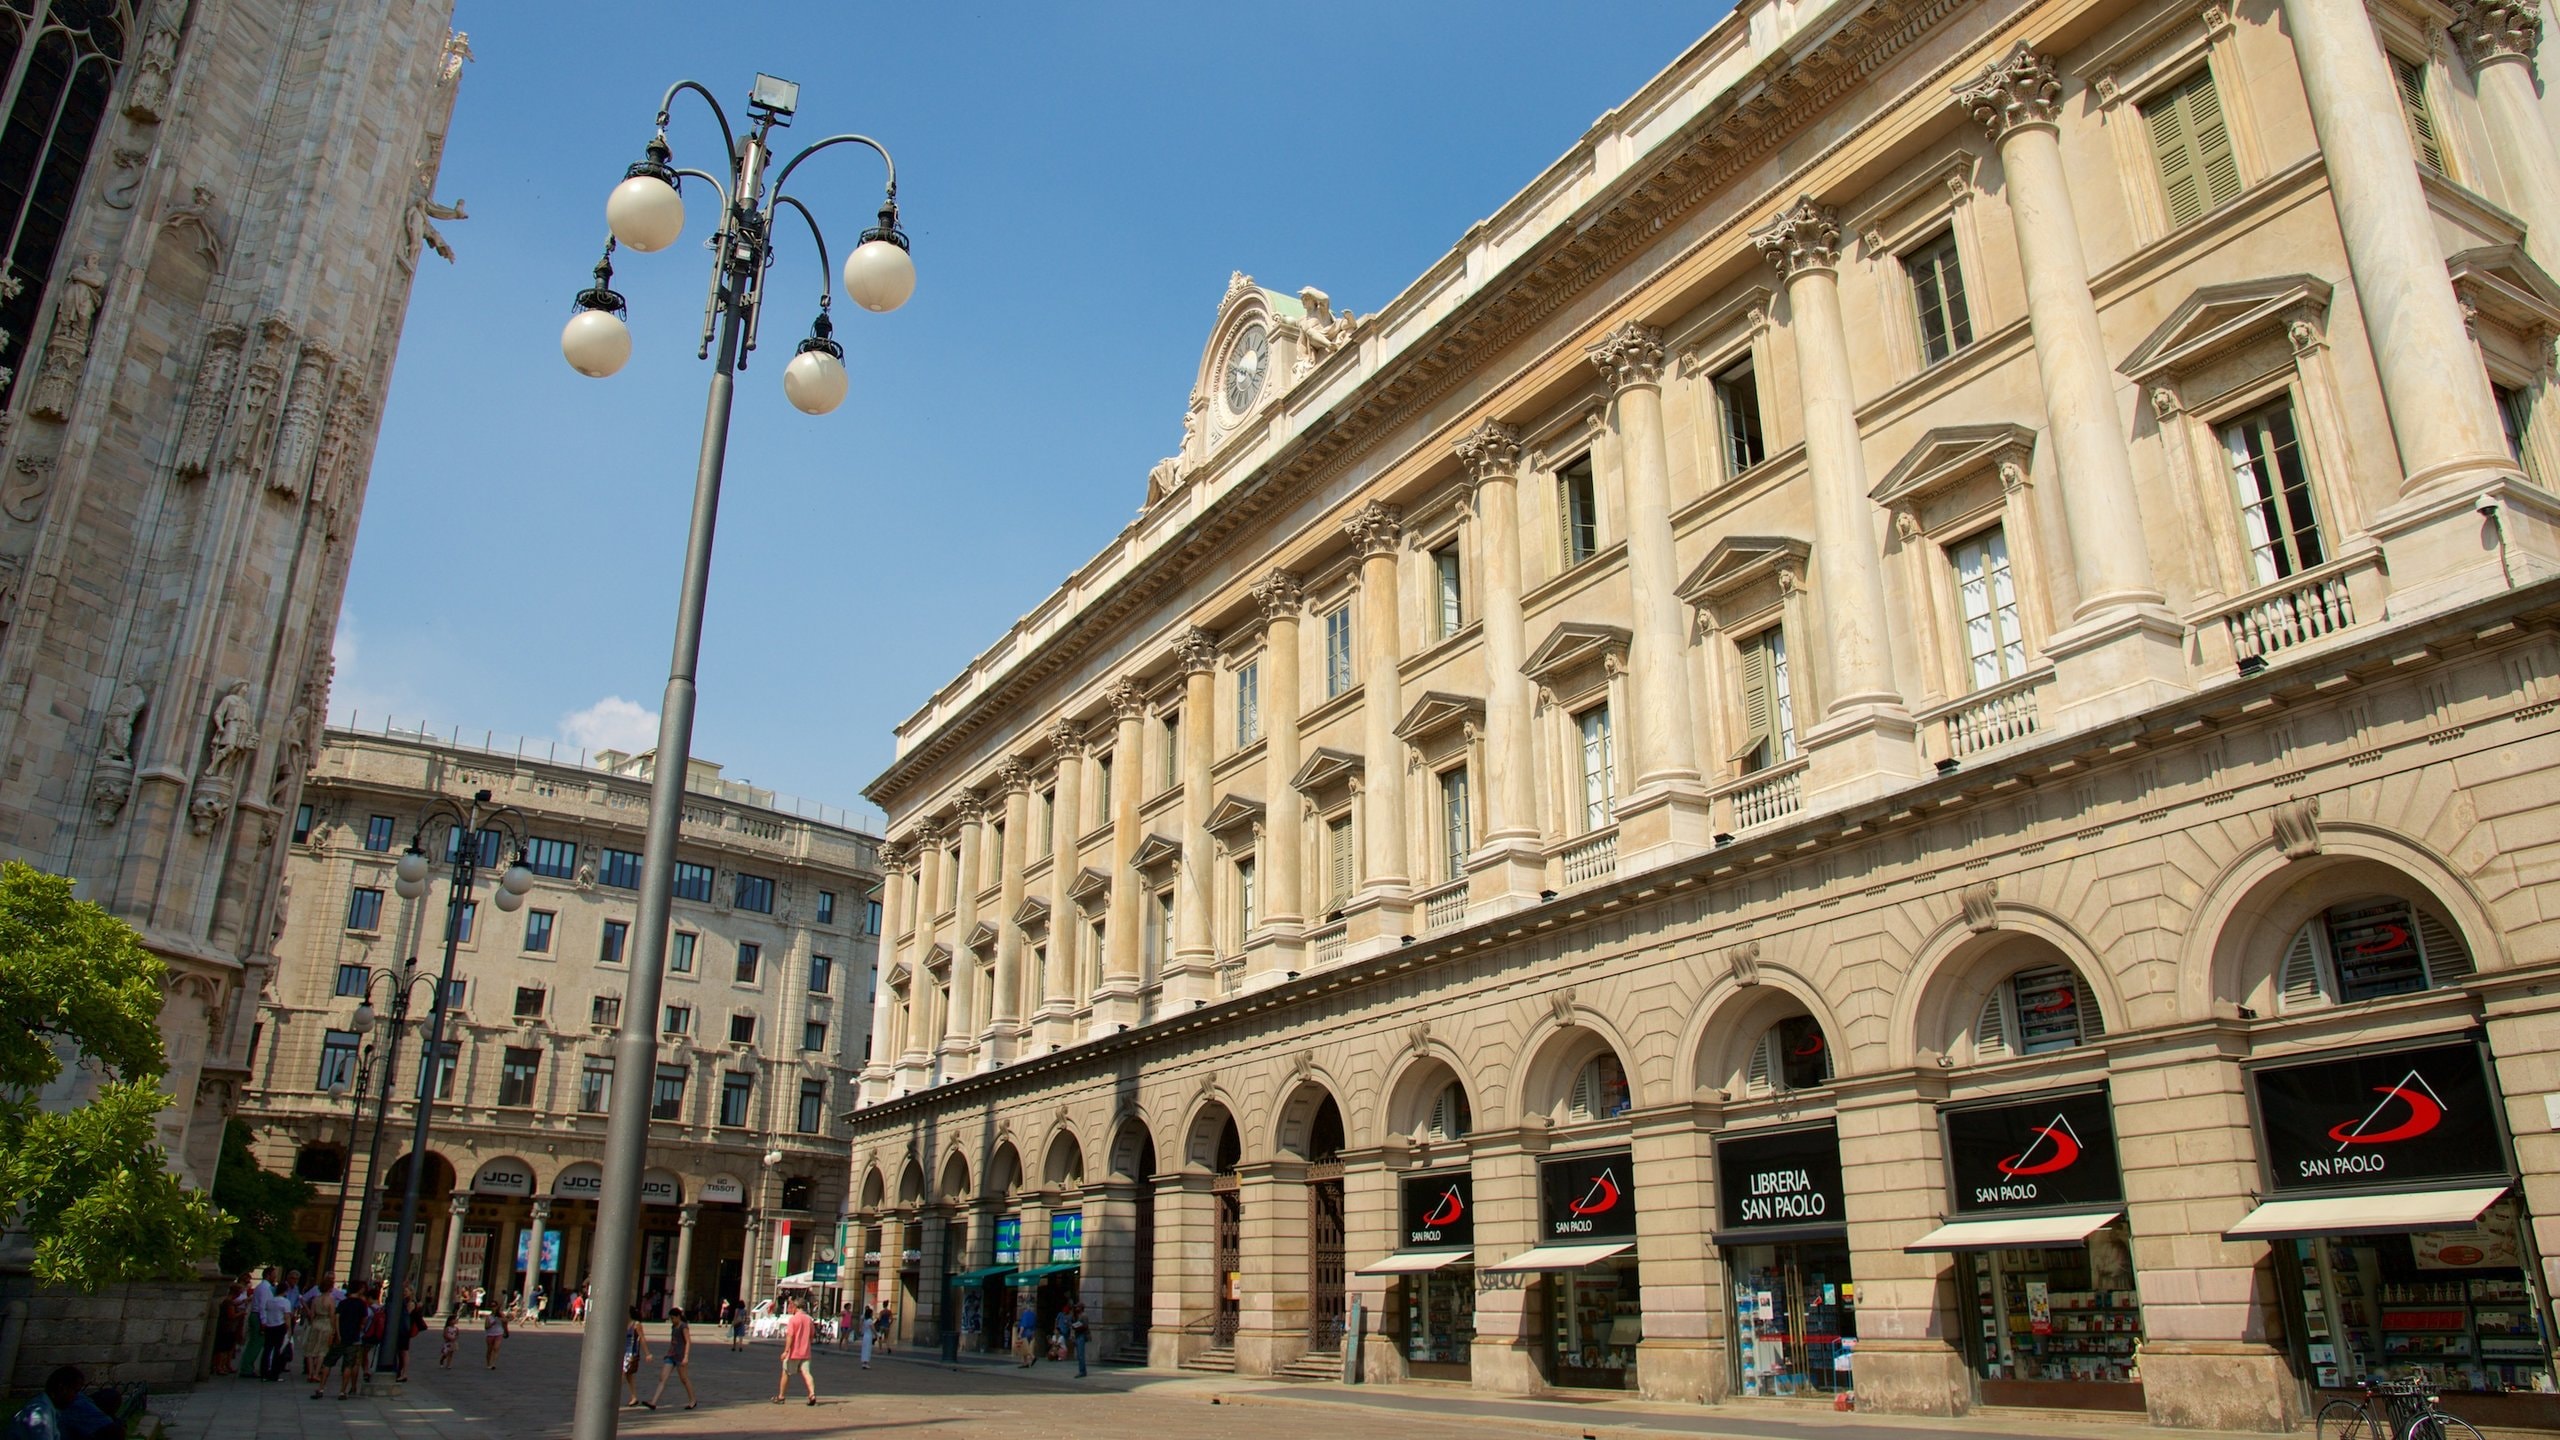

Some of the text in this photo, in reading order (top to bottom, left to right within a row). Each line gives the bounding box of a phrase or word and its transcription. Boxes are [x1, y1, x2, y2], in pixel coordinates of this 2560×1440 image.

[2299, 1154, 2385, 1178] SAN PAOLO
[483, 1171, 523, 1184] JDC
[563, 1176, 601, 1188] JDC
[1750, 1168, 1811, 1195] LIBRERIA
[641, 1182, 671, 1193] JDC
[707, 1184, 736, 1192] TISSOT
[1975, 1183, 2037, 1203] SAN PAOLO
[1741, 1192, 1825, 1221] SAN PAOLO
[1555, 1219, 1593, 1234] SAN PAOLO
[1411, 1230, 1441, 1242] SAN PAOLO
